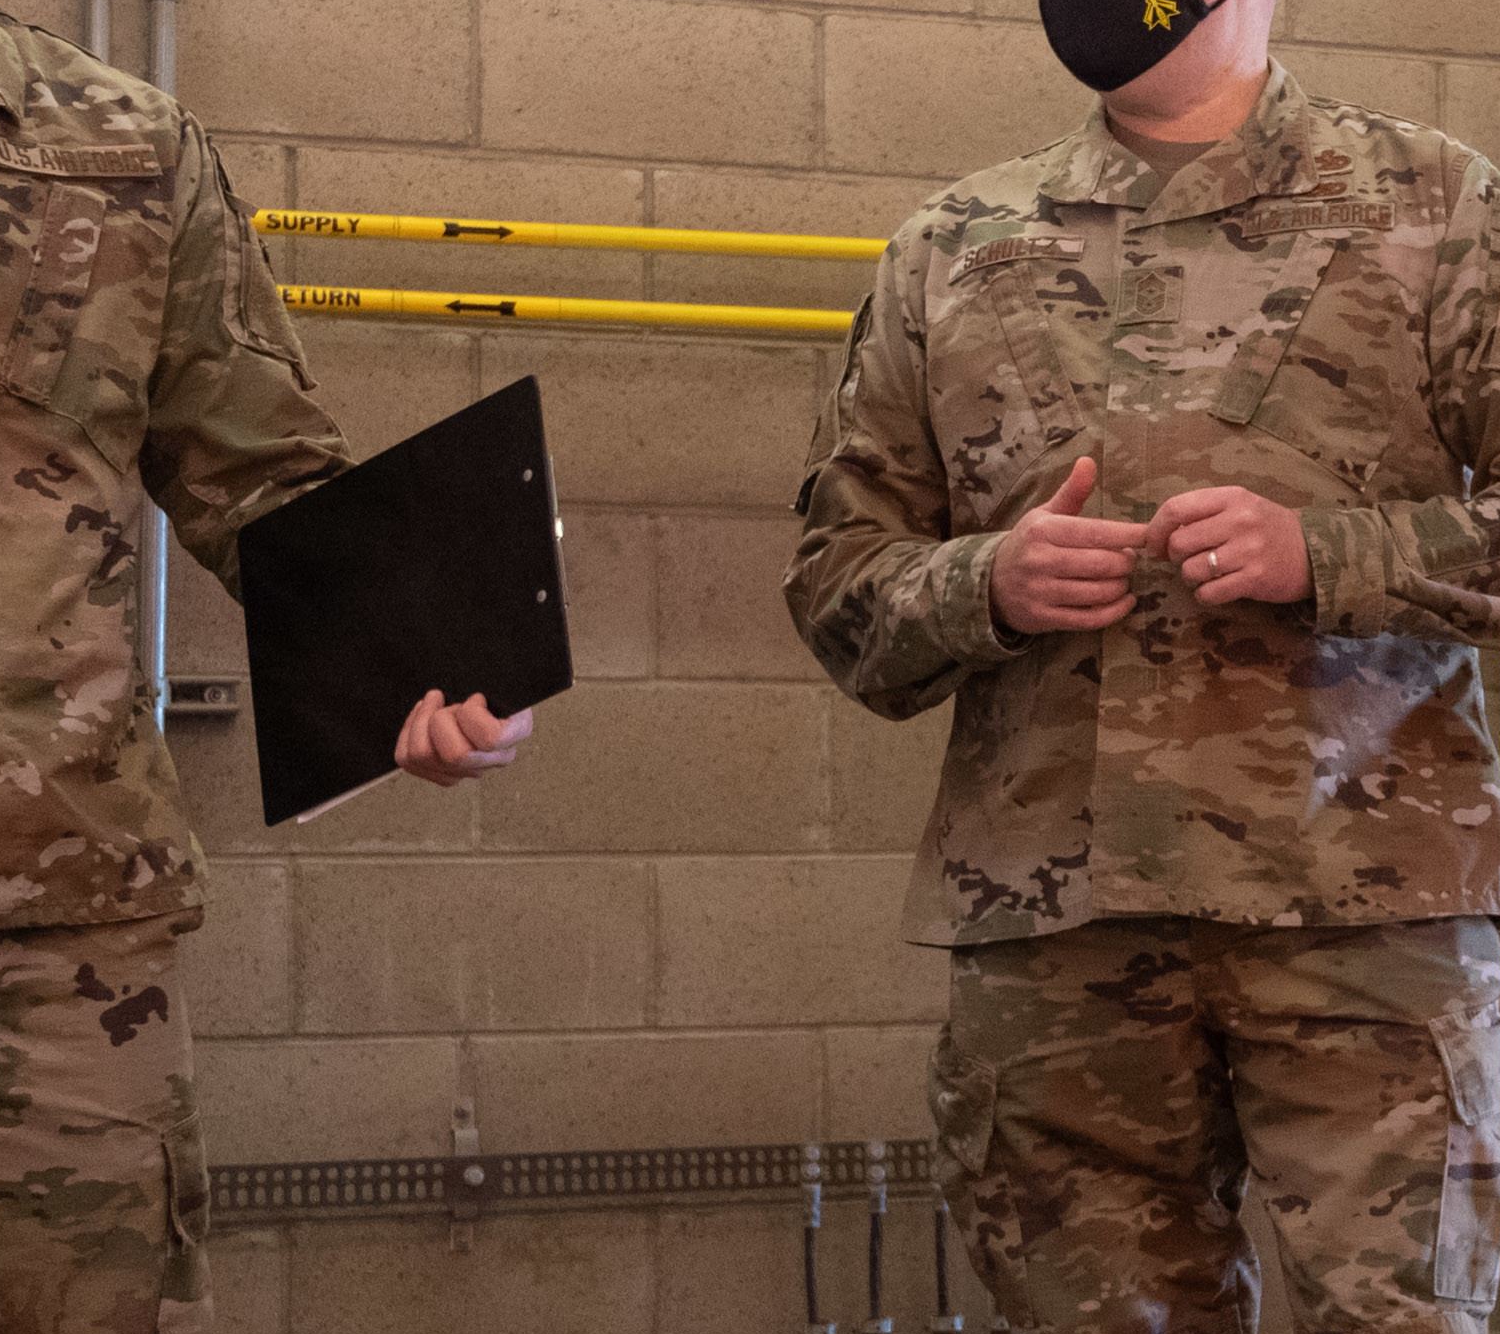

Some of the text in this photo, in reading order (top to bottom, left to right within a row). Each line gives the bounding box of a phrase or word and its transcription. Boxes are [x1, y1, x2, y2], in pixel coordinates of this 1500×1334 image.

[40, 148, 77, 172] AIR
[79, 150, 155, 173] FORCE
[266, 214, 360, 233] SUPPLY
[1291, 207, 1323, 227] AIR
[1327, 204, 1391, 228] FORCE
[964, 238, 1057, 269] SCHULTZ
[283, 289, 360, 307] ETURN
